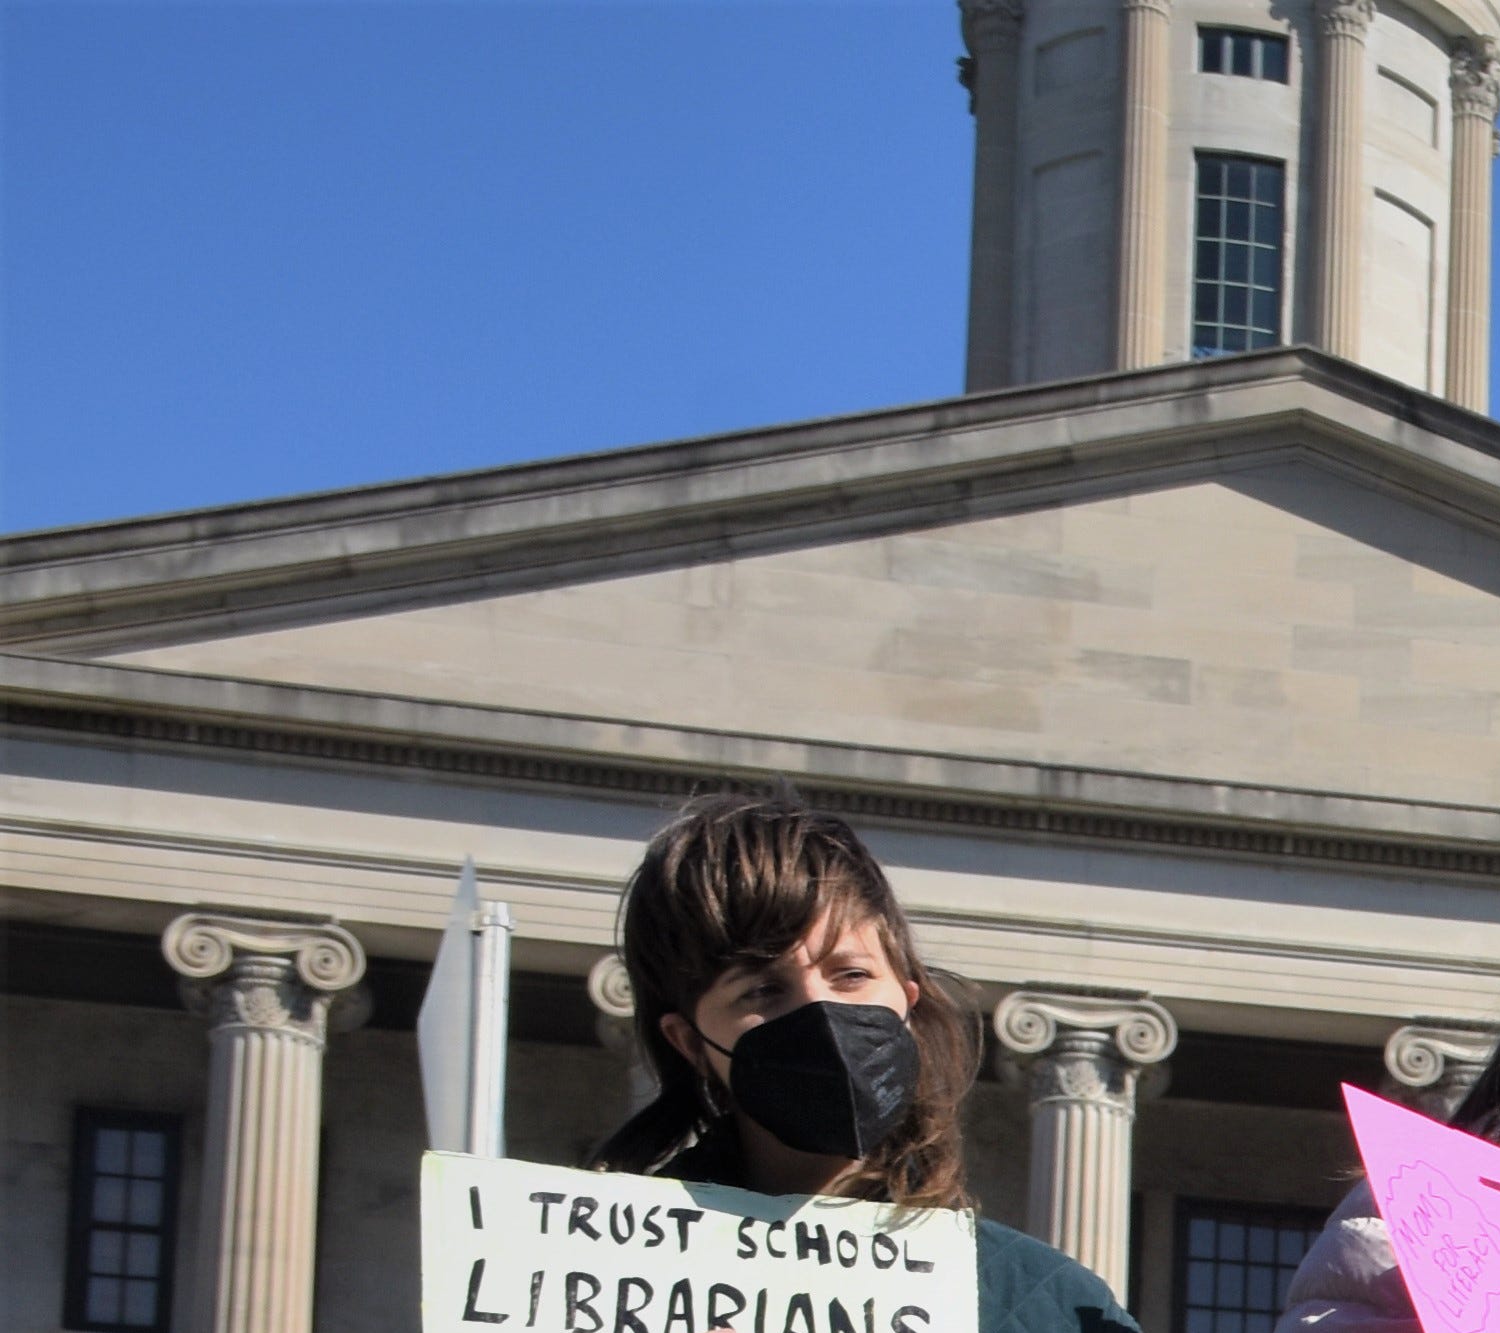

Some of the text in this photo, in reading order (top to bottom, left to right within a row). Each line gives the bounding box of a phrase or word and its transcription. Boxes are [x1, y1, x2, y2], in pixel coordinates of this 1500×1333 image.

[468, 1185, 936, 1275] I TRUST SCHOOL
[1392, 1181, 1453, 1260] MOMS
[1433, 1233, 1470, 1276] FOR
